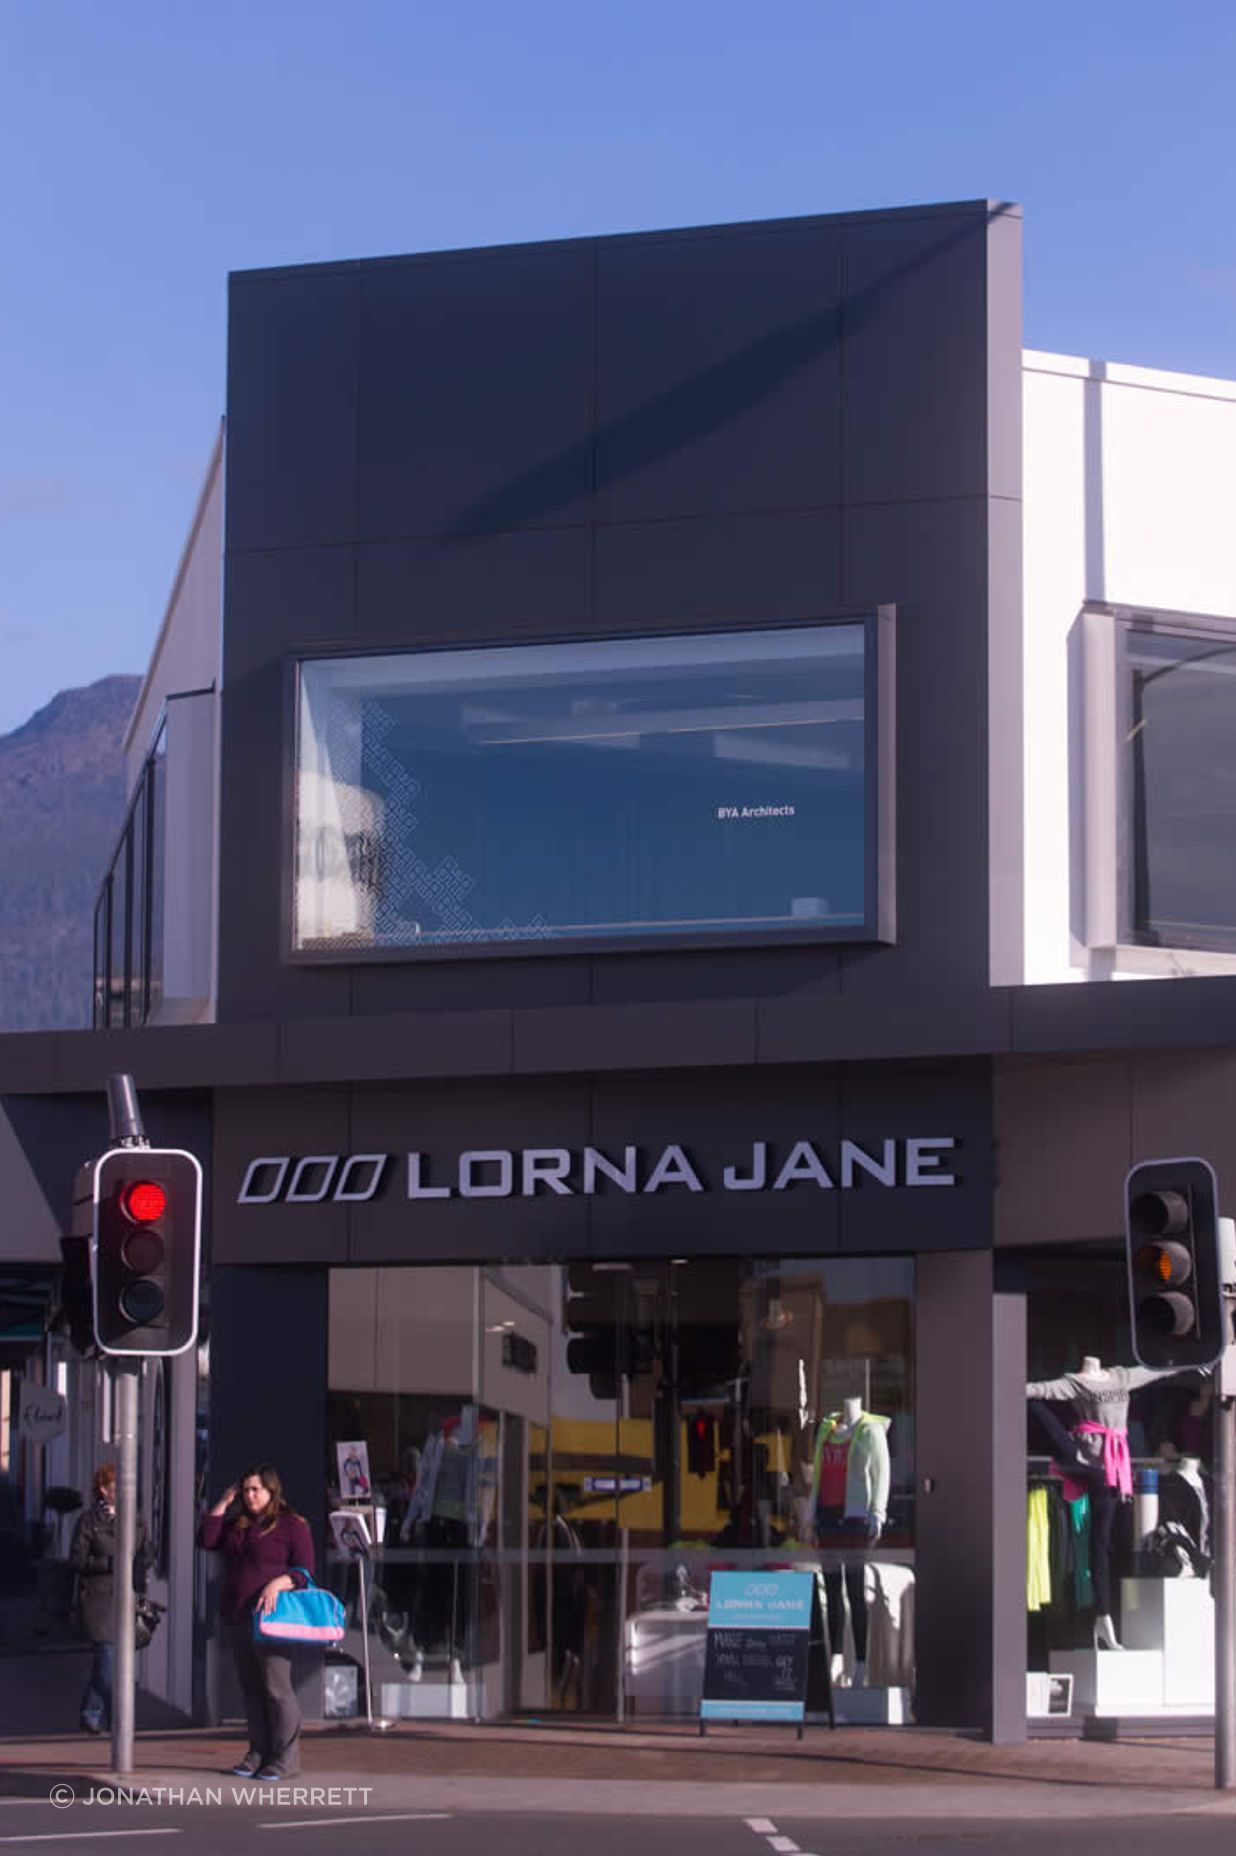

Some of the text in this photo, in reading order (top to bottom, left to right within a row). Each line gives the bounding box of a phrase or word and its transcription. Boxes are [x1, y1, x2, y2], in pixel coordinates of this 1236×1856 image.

[718, 805, 795, 819] BYA Architects
[407, 1136, 956, 1200] LORNA JANE
